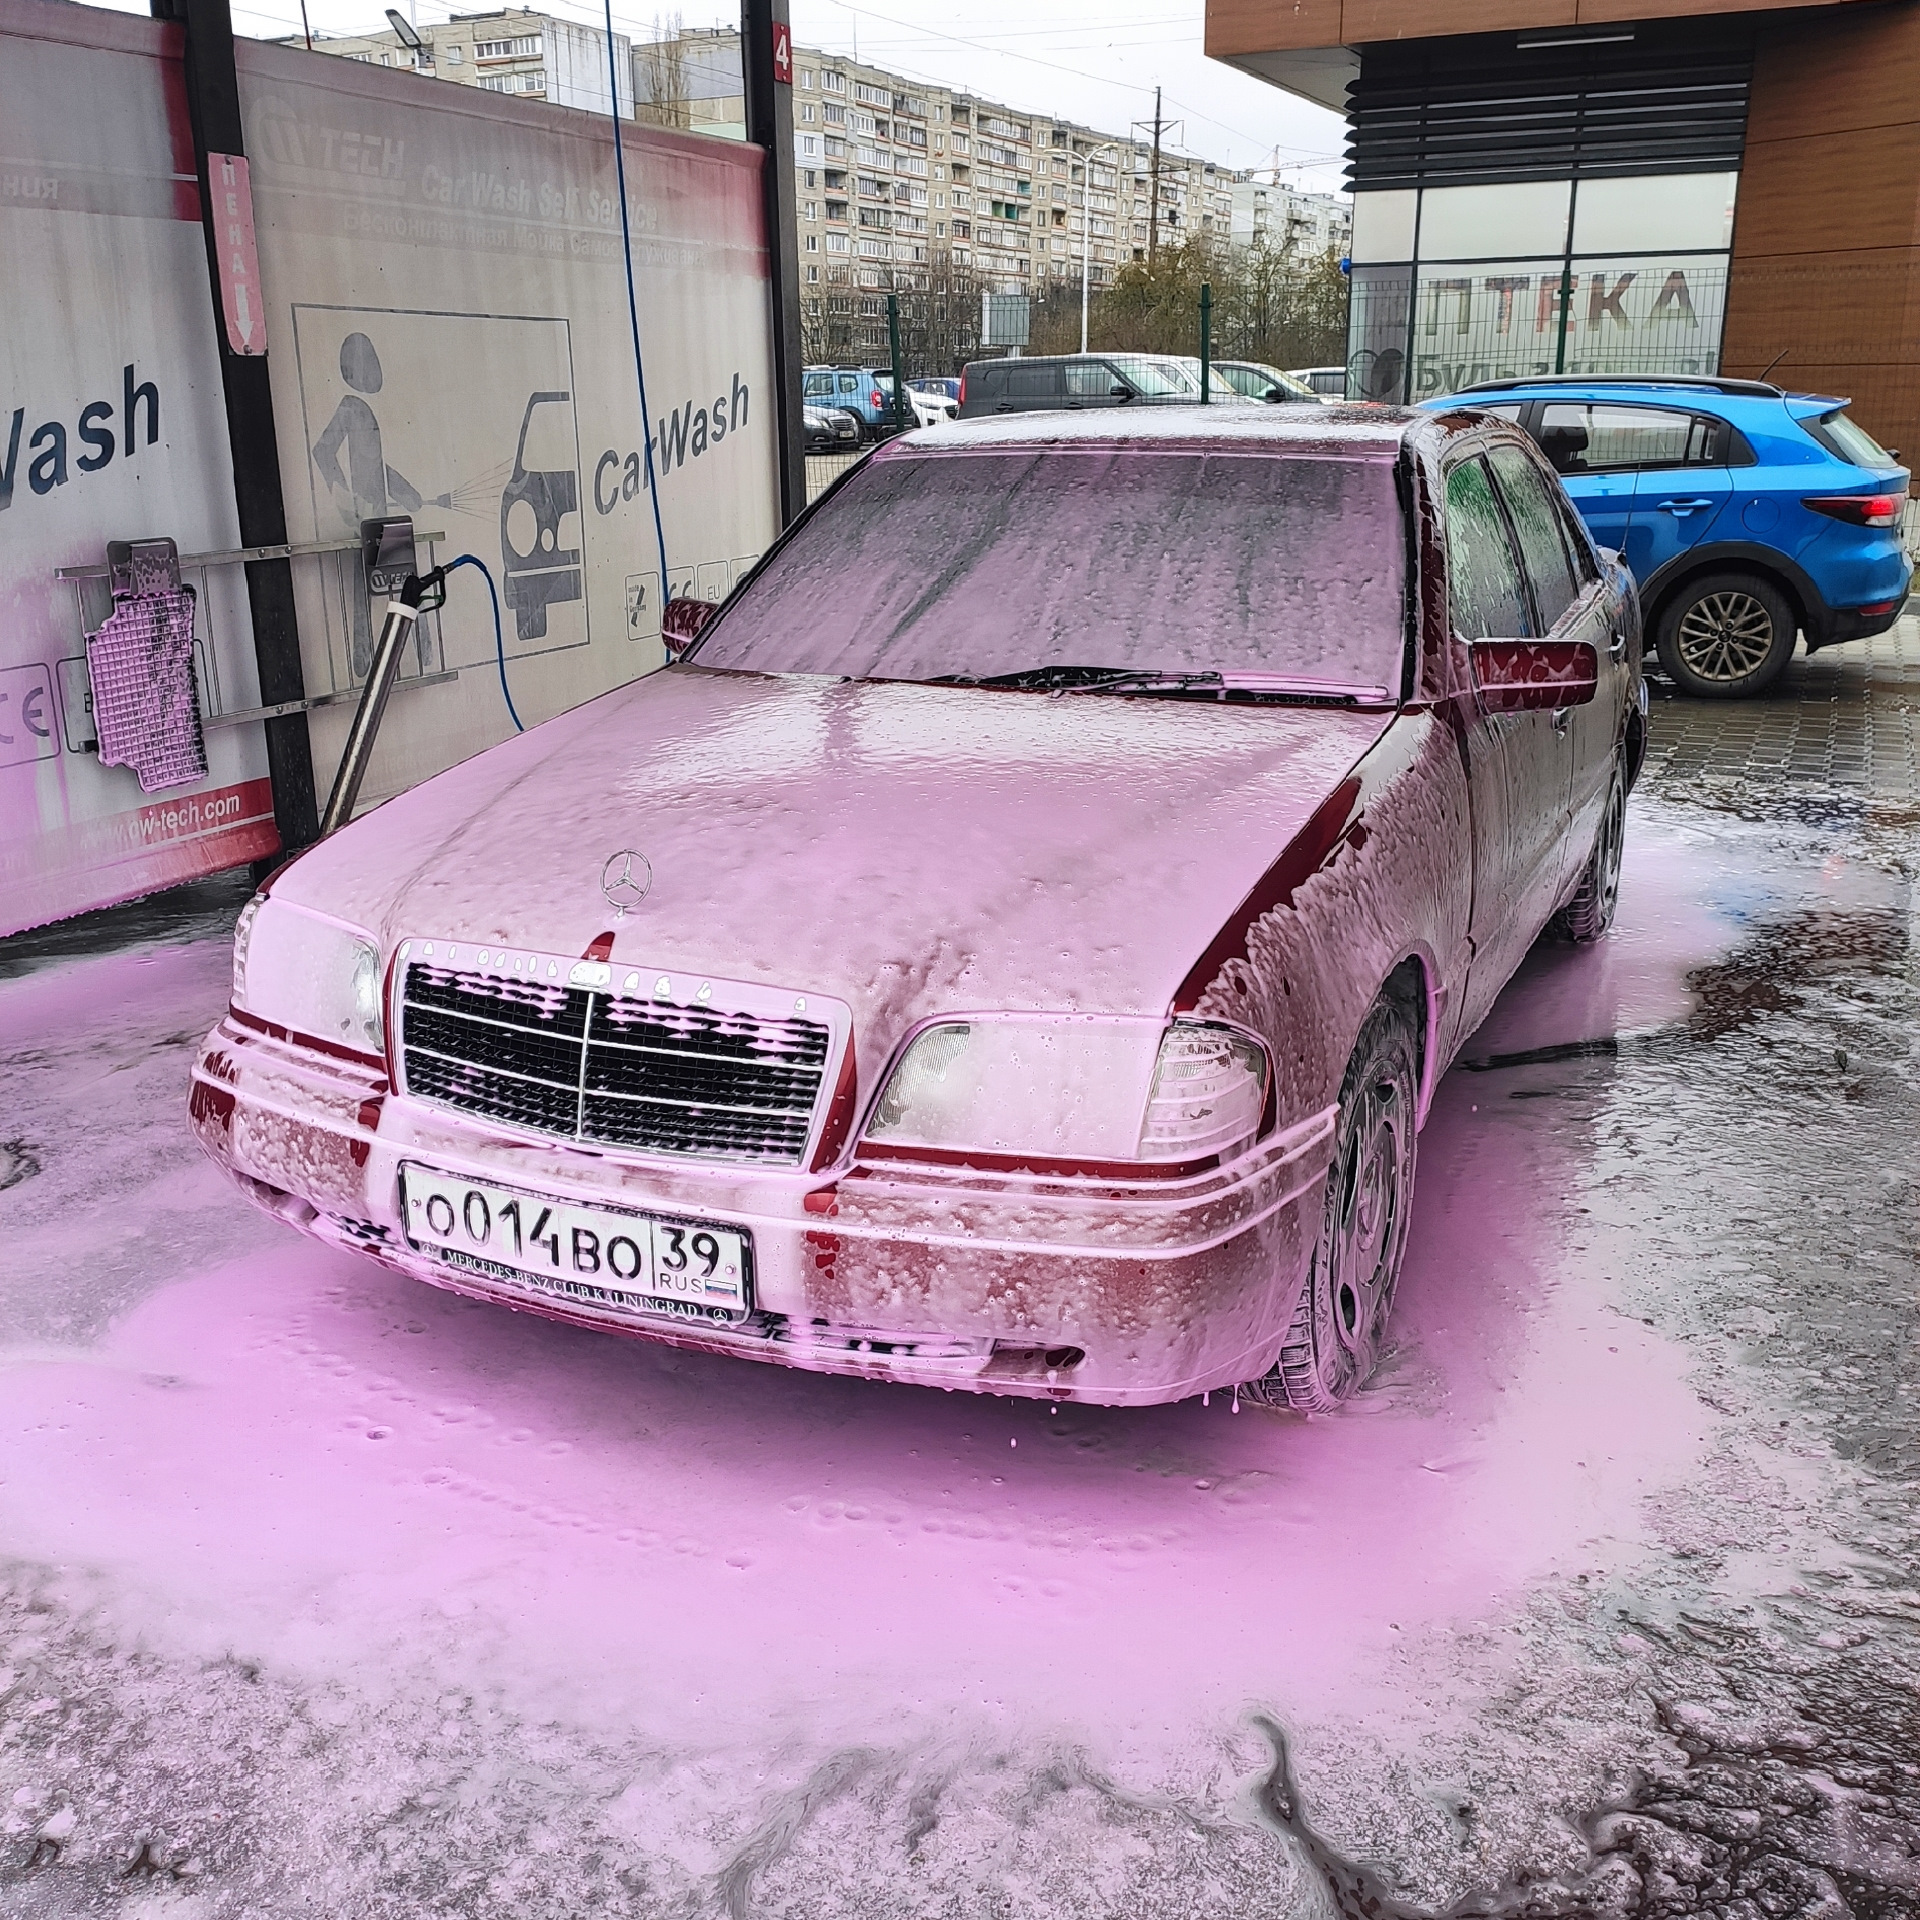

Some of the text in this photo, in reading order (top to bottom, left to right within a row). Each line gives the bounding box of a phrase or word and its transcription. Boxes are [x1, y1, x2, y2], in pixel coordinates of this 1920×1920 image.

[775, 33, 789, 71] 4
[221, 163, 246, 274] ПЕНА
[421, 163, 659, 231] Car Wash Self Serice
[1368, 270, 1699, 337] ПТЕКА
[594, 371, 749, 516] CarWash
[707, 583, 721, 600] EU
[446, 1250, 698, 1318] MERCEDES-BENZ CLUB KALININGRAD
[659, 1273, 703, 1294] RUS
[660, 1226, 720, 1277] 39
